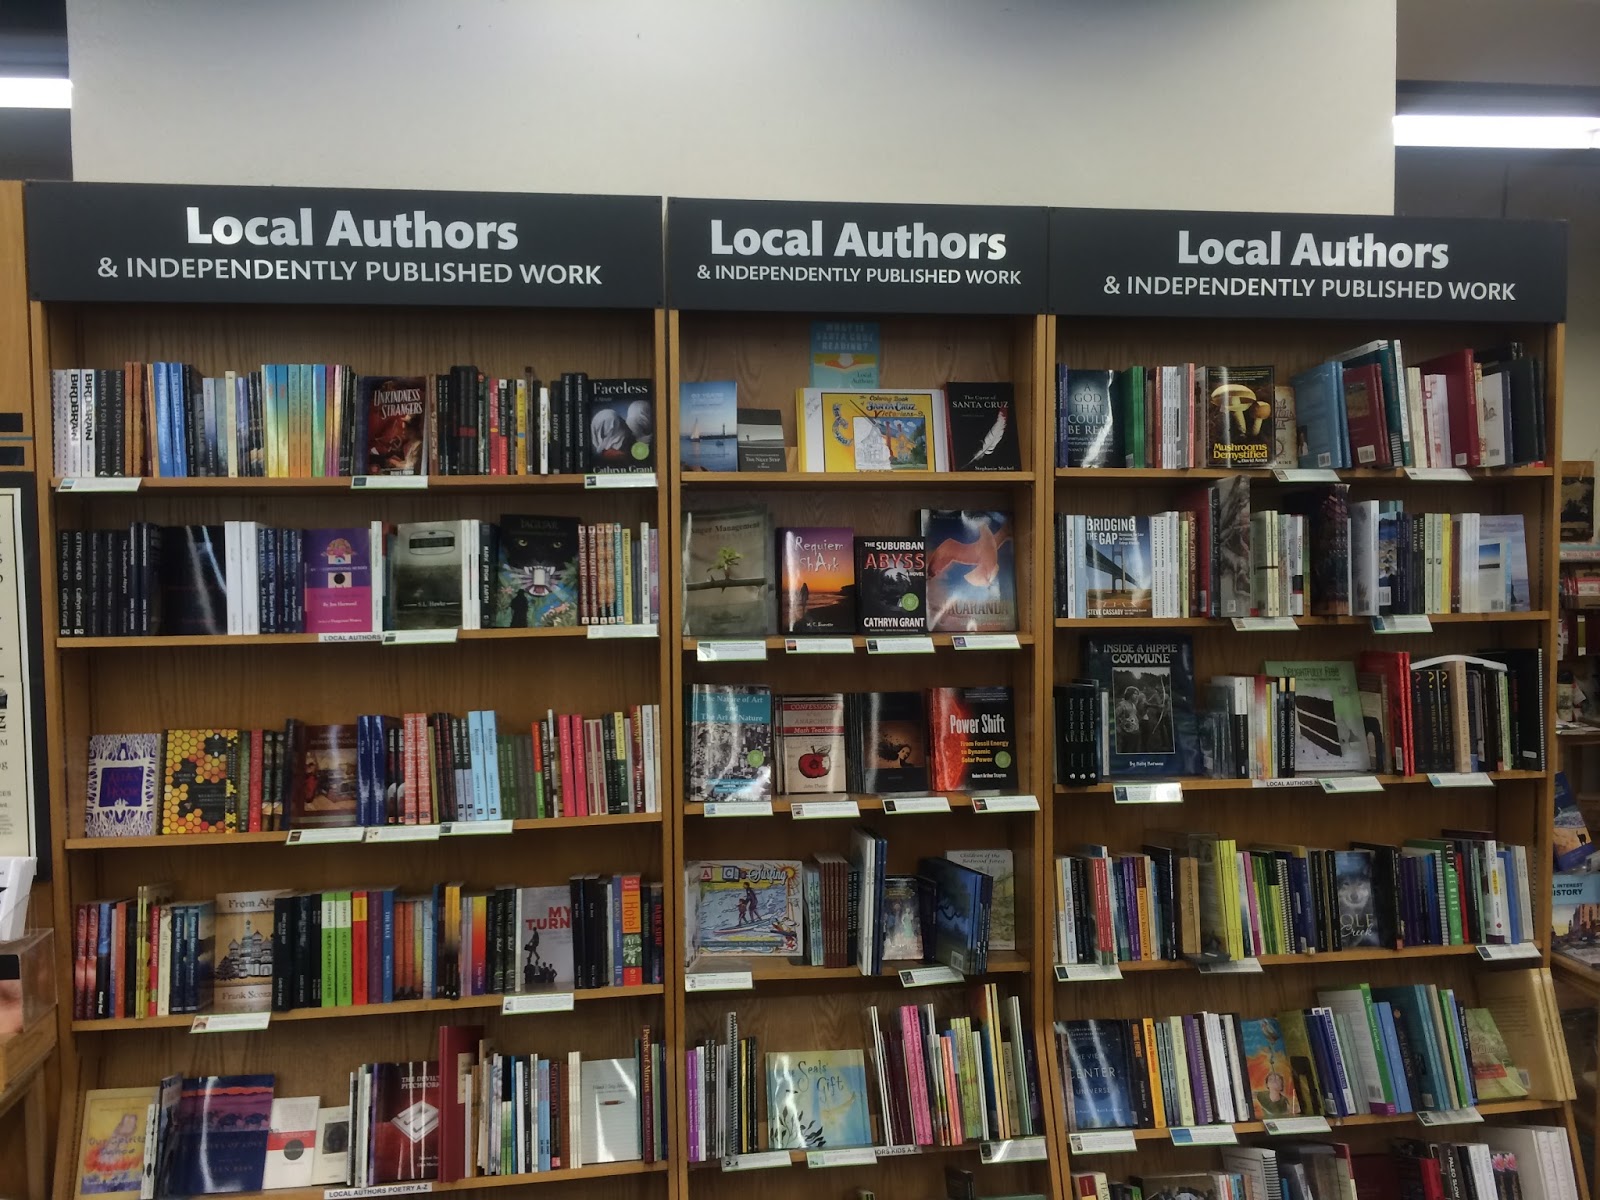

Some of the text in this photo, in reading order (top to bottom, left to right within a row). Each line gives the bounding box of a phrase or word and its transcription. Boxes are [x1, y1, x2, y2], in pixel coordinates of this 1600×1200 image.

[187, 207, 518, 250] Local Authors
[711, 220, 1006, 260] Local Authors
[1178, 230, 1449, 269] Local Authors
[98, 257, 602, 285] & INDEPENDENTLY PUBLISHED WORK
[697, 264, 1022, 286] & INDEPENDENTLY PUBLISHED WORK
[1104, 276, 1516, 301] & INDEPENDENTLY PUBLISHED WORK
[593, 382, 648, 395] Faceless
[1084, 384, 1091, 392] A
[374, 388, 420, 406] UNKINDNESS
[1075, 393, 1102, 402] GOD
[382, 402, 422, 419] STRANGERS
[866, 402, 916, 411] SANTA CRUZ
[1075, 404, 1104, 413] THAT
[1068, 425, 1082, 434] BE
[1213, 443, 1267, 451] Mushrooms
[1213, 450, 1268, 459] Demystified
[629, 465, 653, 473] Grant
[715, 522, 760, 532] Management
[1087, 518, 1135, 532] BRIDGING
[1087, 533, 1097, 541] THE
[1100, 532, 1117, 545] GAP
[795, 536, 844, 555] Requiem
[876, 542, 924, 550] SUBURBAN
[864, 553, 925, 569] ABYSS
[948, 602, 1009, 615] ACARANDA
[864, 618, 925, 628] CATHRYN GRANT
[1104, 644, 1178, 653] INSIDE A HIPPIE
[1112, 653, 1170, 663] COMMUNE
[950, 714, 1005, 734] Power Shift
[752, 865, 787, 884] Surfing
[229, 897, 274, 909] From Afa
[548, 906, 571, 918] MY
[624, 901, 639, 930] Hotel
[526, 919, 570, 930] TURN
[1340, 914, 1373, 928] OLF
[817, 1077, 843, 1100] Gift
[1448, 1156, 1460, 1200] PALEO SLOW
